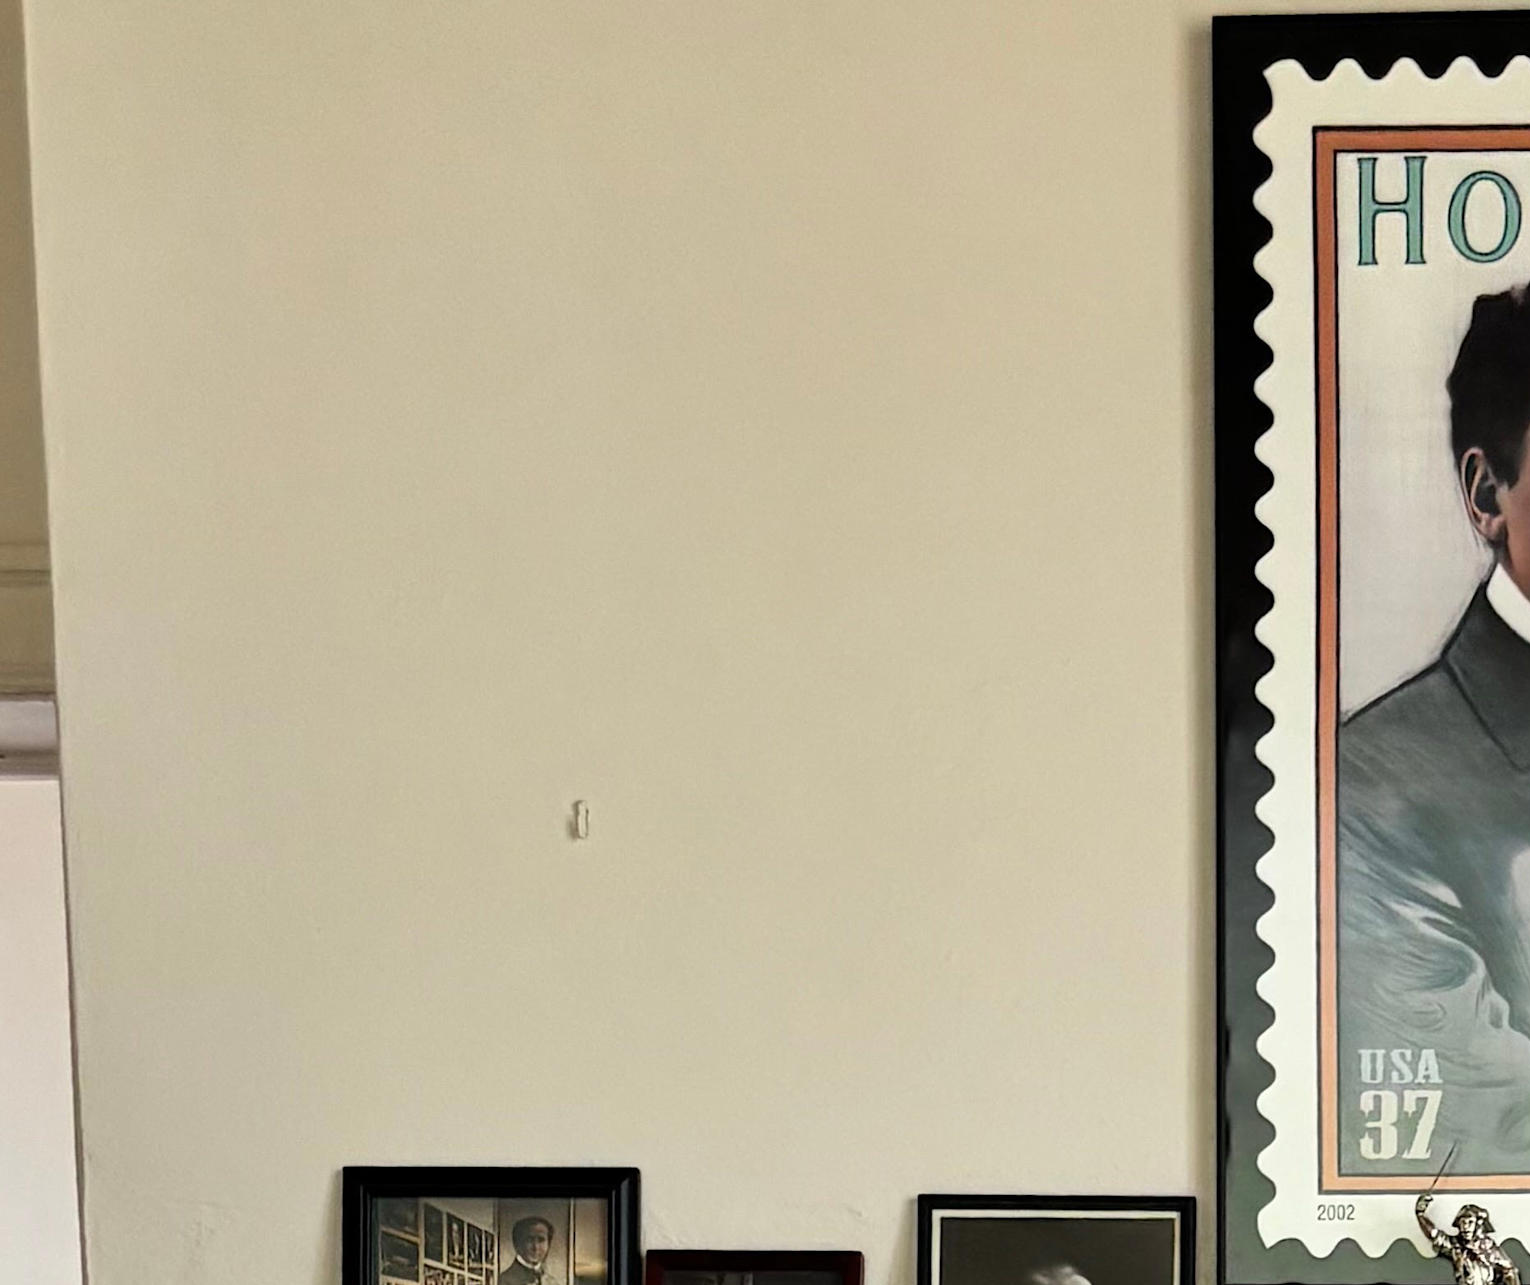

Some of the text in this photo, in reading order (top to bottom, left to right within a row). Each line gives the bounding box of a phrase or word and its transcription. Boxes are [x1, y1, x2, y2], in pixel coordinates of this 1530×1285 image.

[1358, 1048, 1444, 1084] USA
[1359, 1089, 1443, 1160] 37
[1317, 1204, 1355, 1221] 2002
